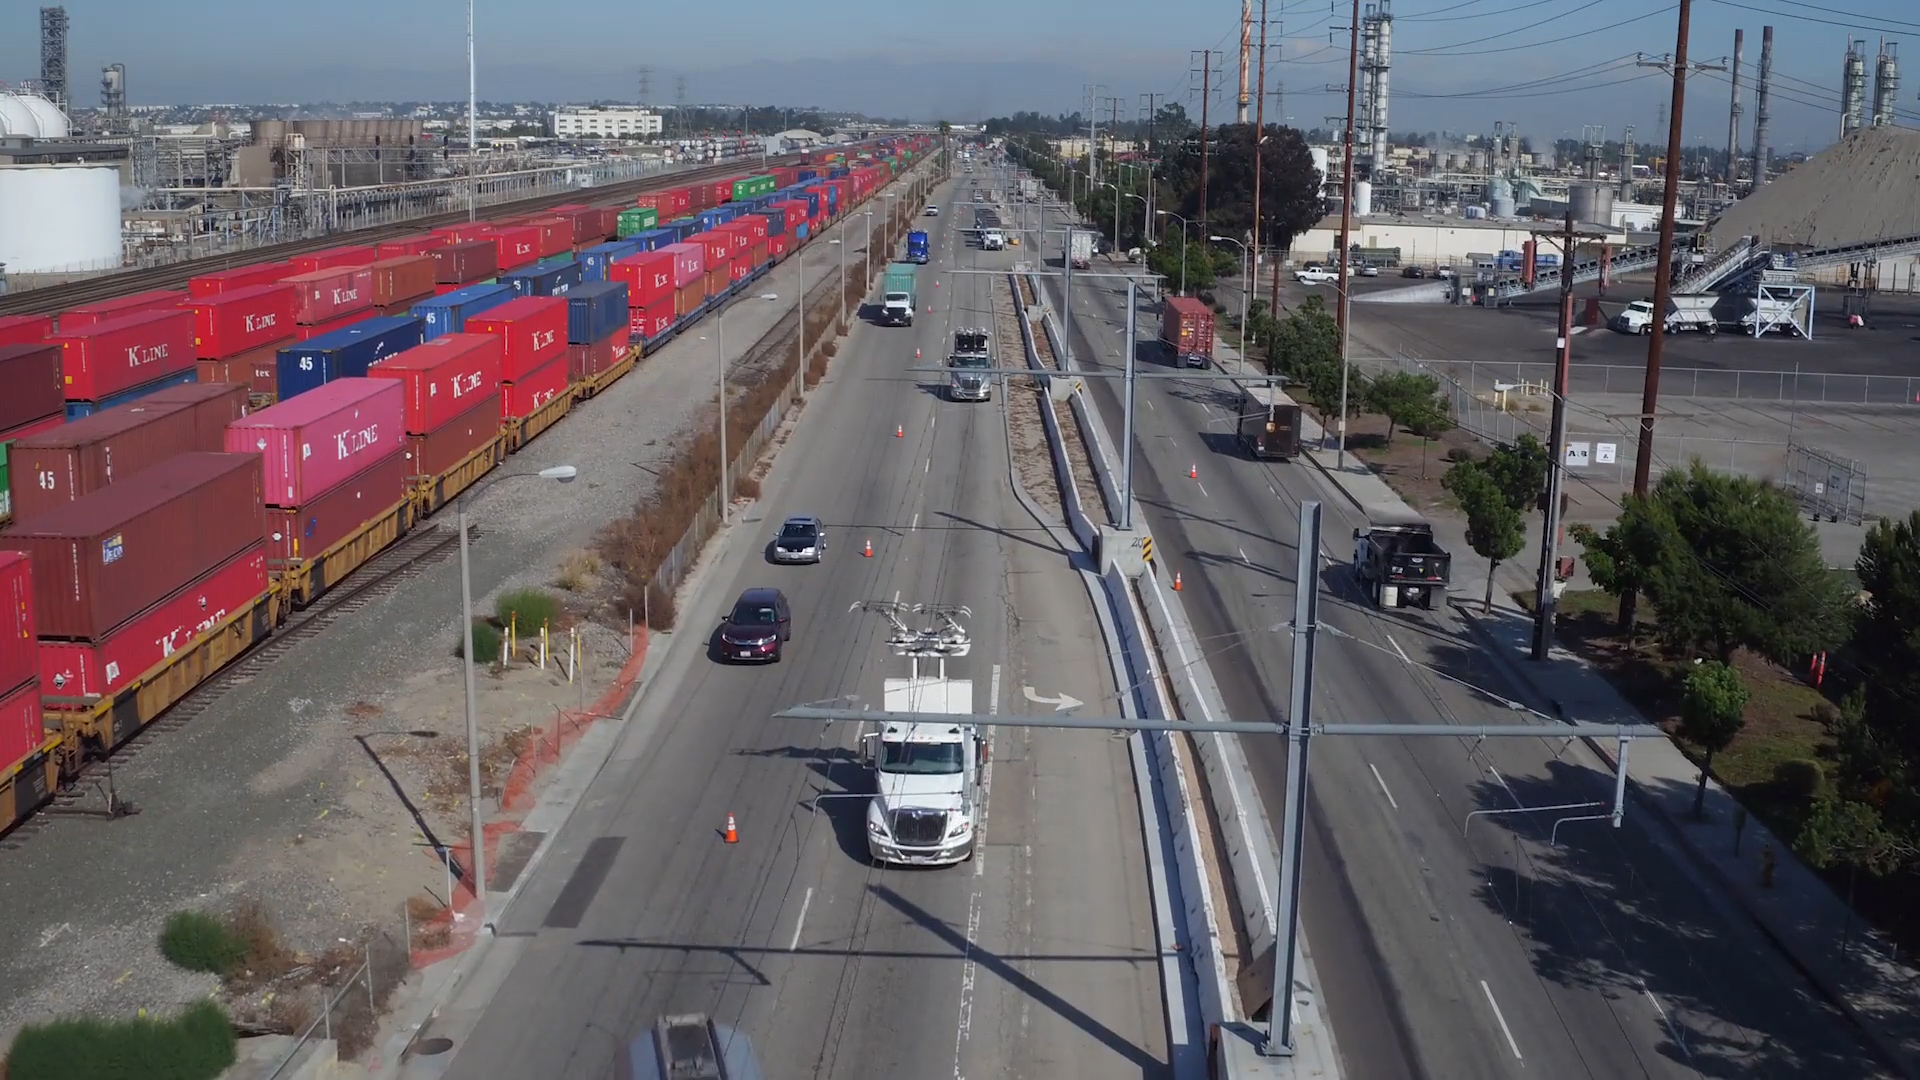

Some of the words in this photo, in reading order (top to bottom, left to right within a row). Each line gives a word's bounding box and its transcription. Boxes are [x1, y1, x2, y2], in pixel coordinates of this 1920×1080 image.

[426, 312, 436, 324] 45
[299, 357, 313, 371] 45
[255, 369, 270, 377] tex
[39, 471, 55, 490] 45
[1131, 537, 1144, 549] 20
